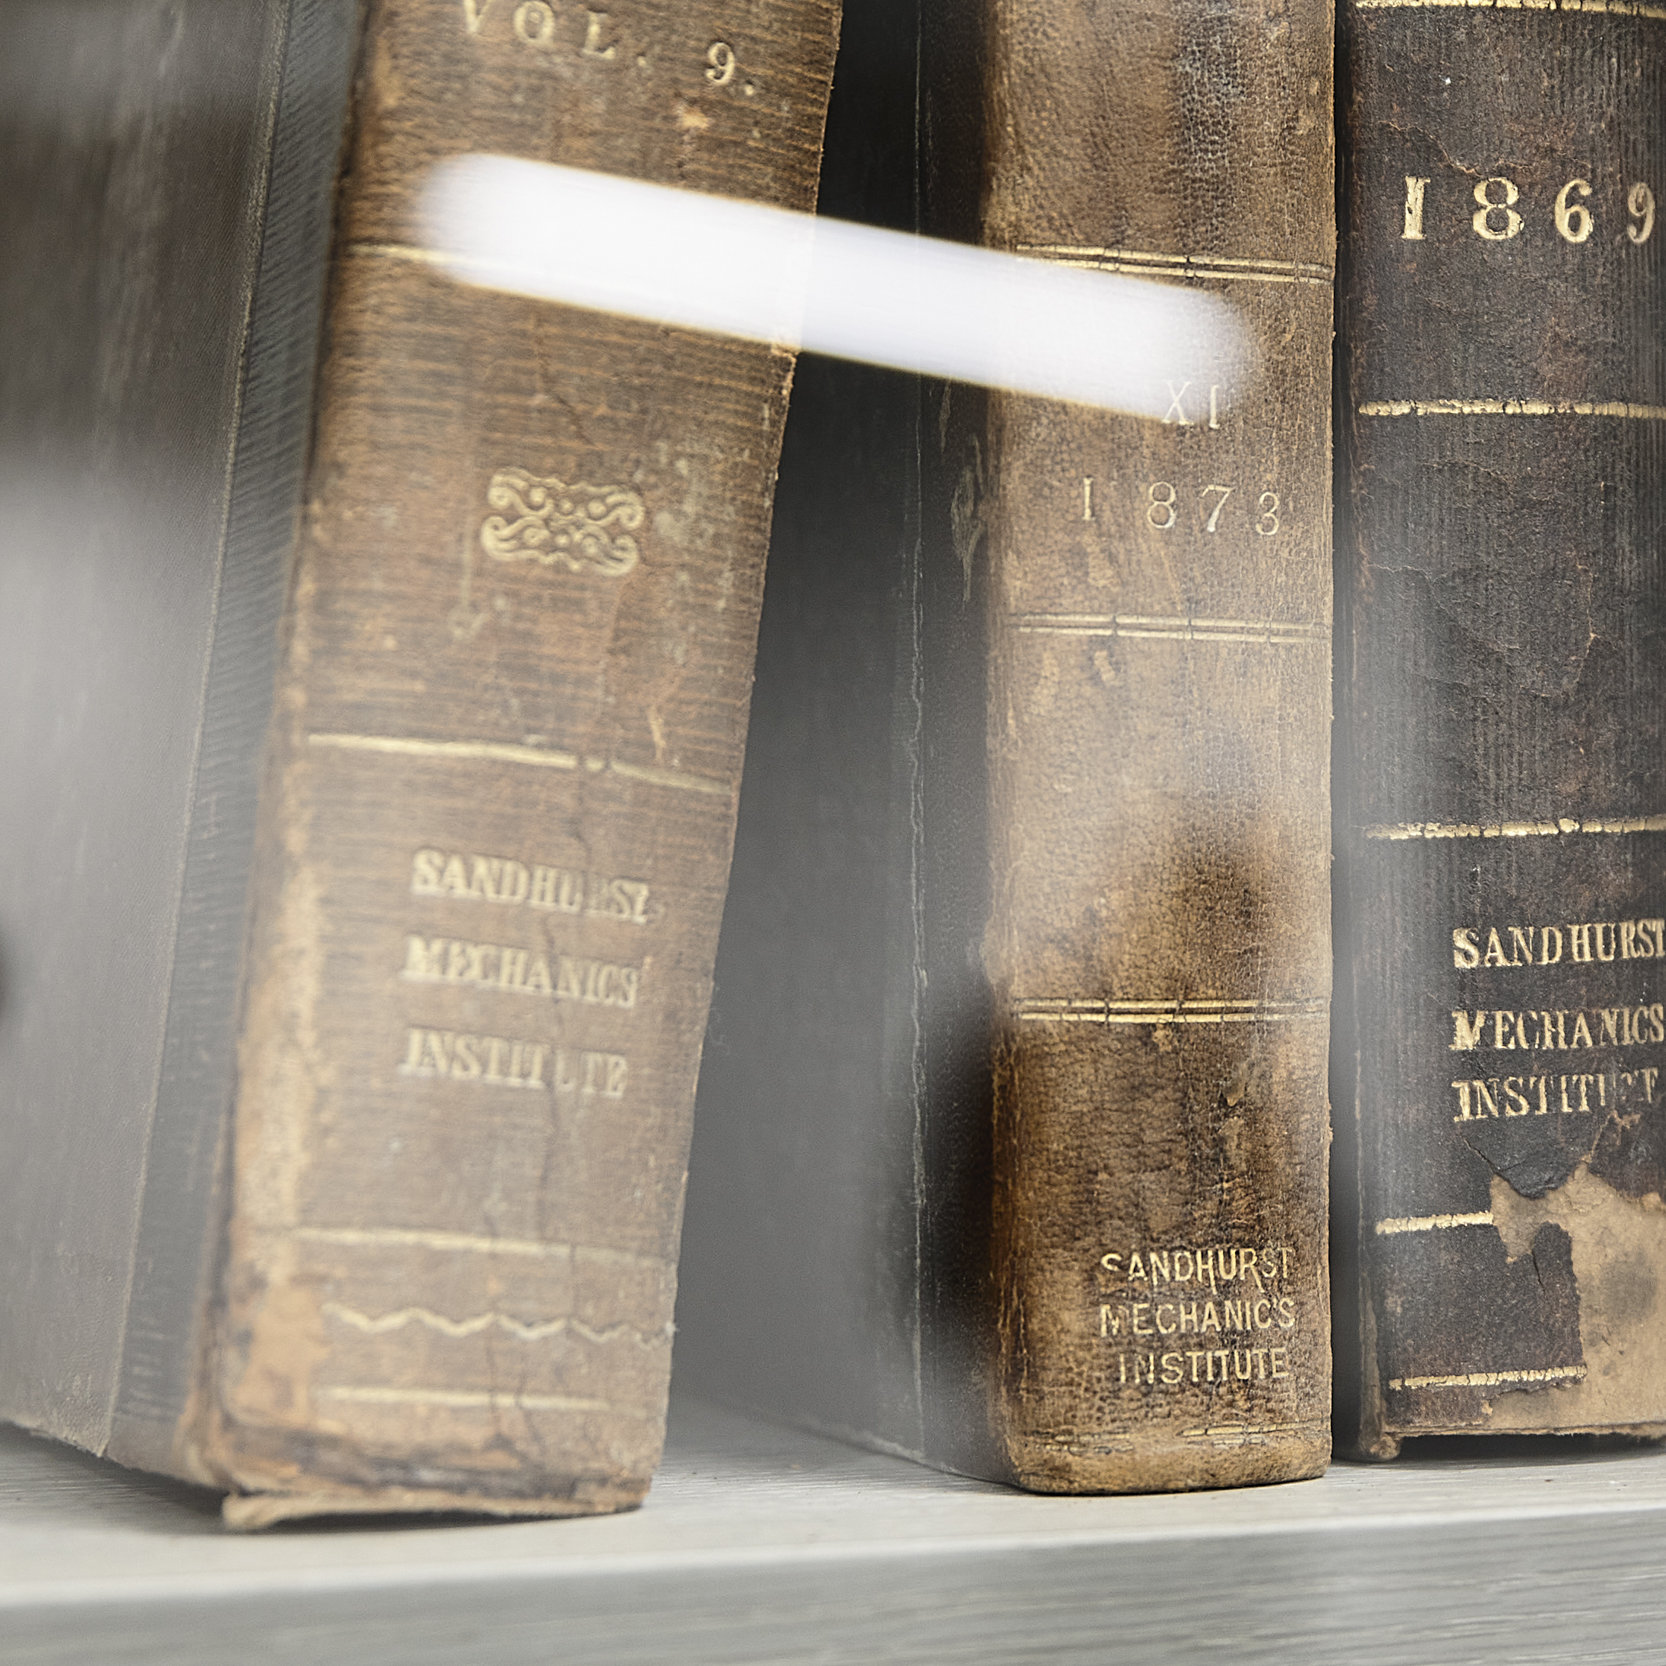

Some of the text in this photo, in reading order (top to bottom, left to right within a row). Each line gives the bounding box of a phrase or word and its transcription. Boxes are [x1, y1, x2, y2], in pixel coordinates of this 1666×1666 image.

[706, 40, 756, 98] 9.
[1401, 175, 1656, 244] 1869
[1081, 477, 1281, 536] 1873
[1451, 919, 1666, 970] SANDHURST
[1449, 1003, 1665, 1051] MECHANICS
[1100, 1247, 1293, 1295] SANDHURST
[1117, 1347, 1290, 1384] INSTITUTE
